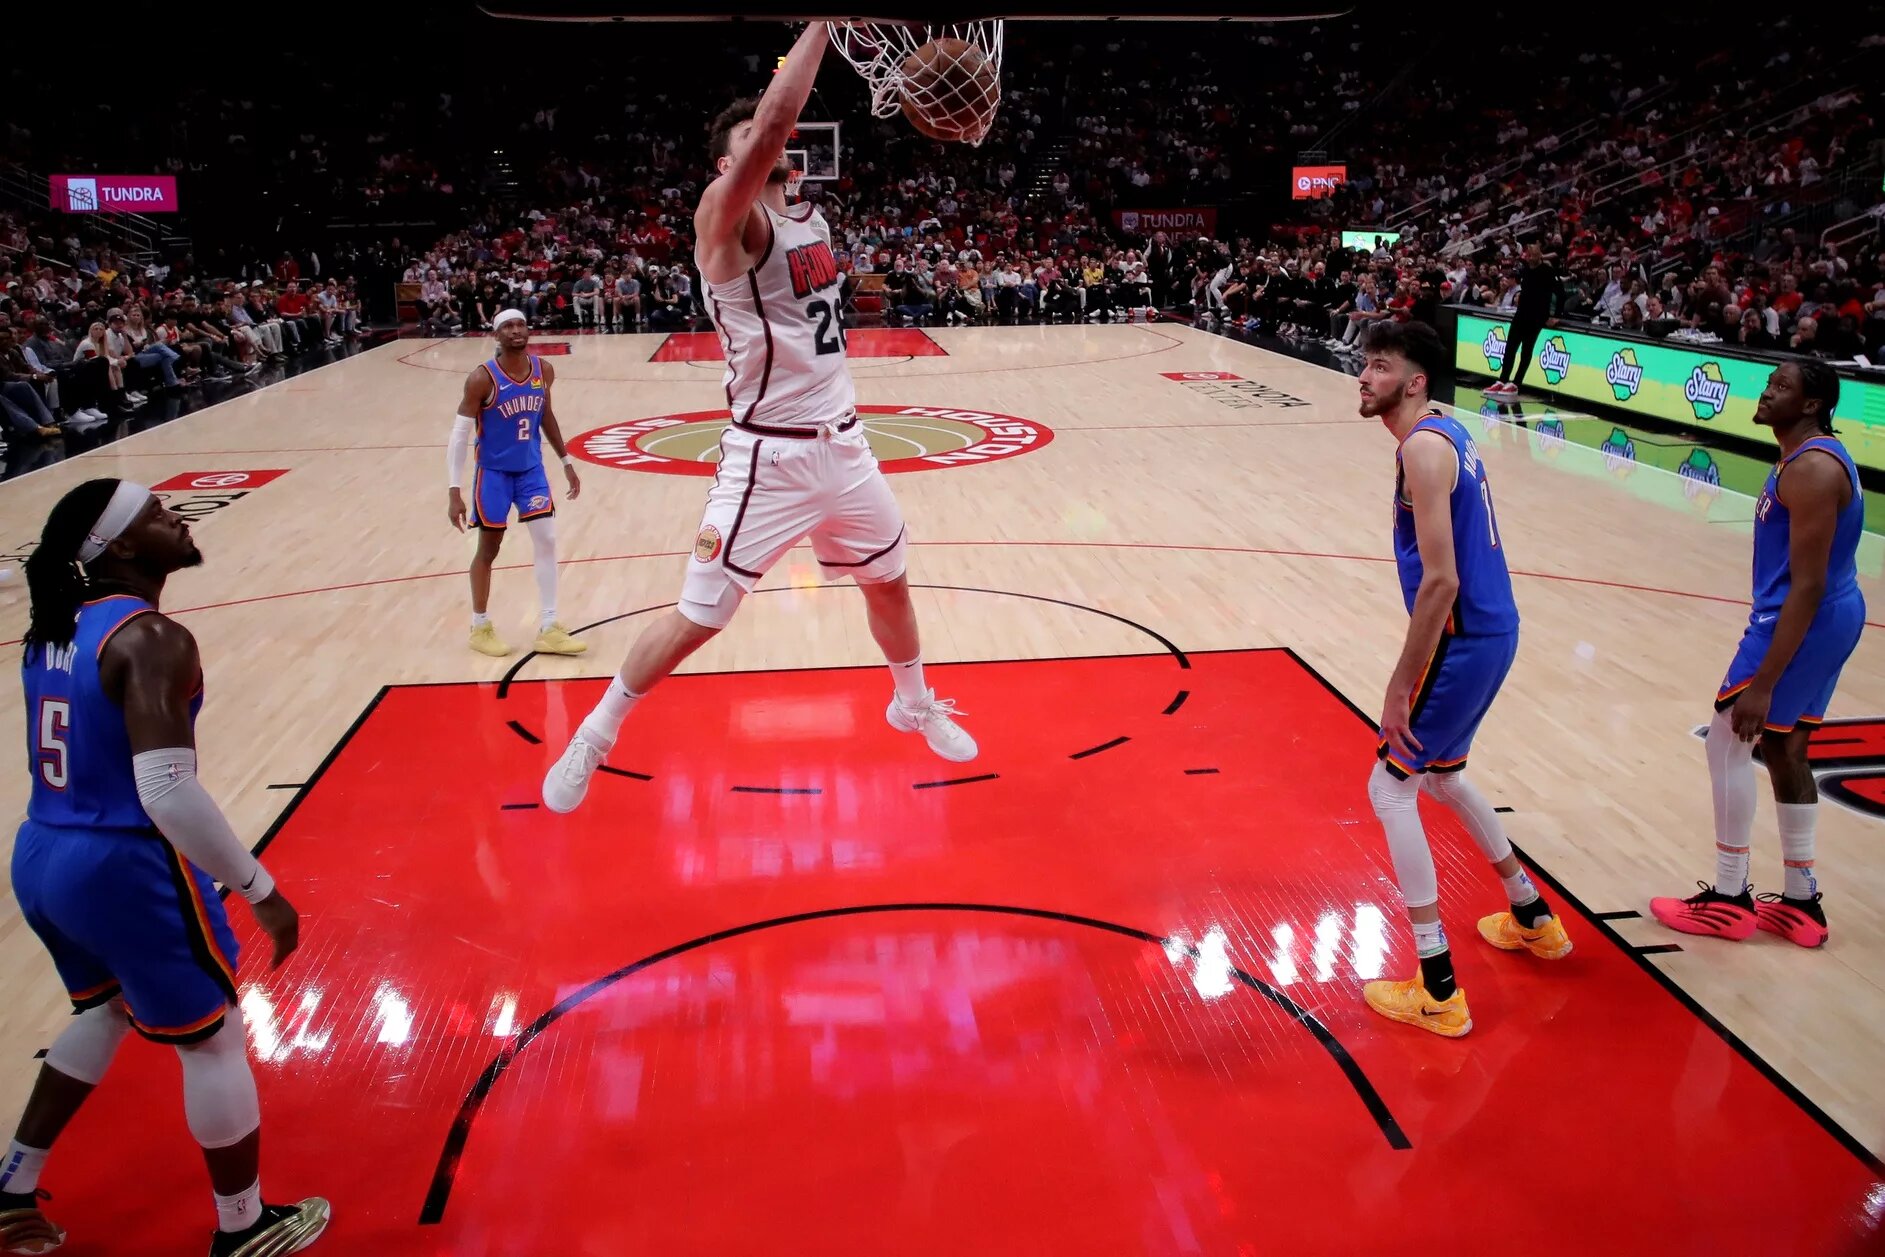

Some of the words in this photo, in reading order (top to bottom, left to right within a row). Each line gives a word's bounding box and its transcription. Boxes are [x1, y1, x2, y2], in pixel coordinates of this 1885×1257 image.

[102, 187, 164, 201] TUNDRA
[1141, 213, 1205, 228] TUNDRA
[1540, 340, 1571, 379] Starry
[1606, 352, 1643, 395] Starry
[1685, 366, 1730, 414] Starry
[518, 418, 530, 441] 2
[896, 407, 1038, 465] HOUSTON
[38, 696, 70, 792] 5
